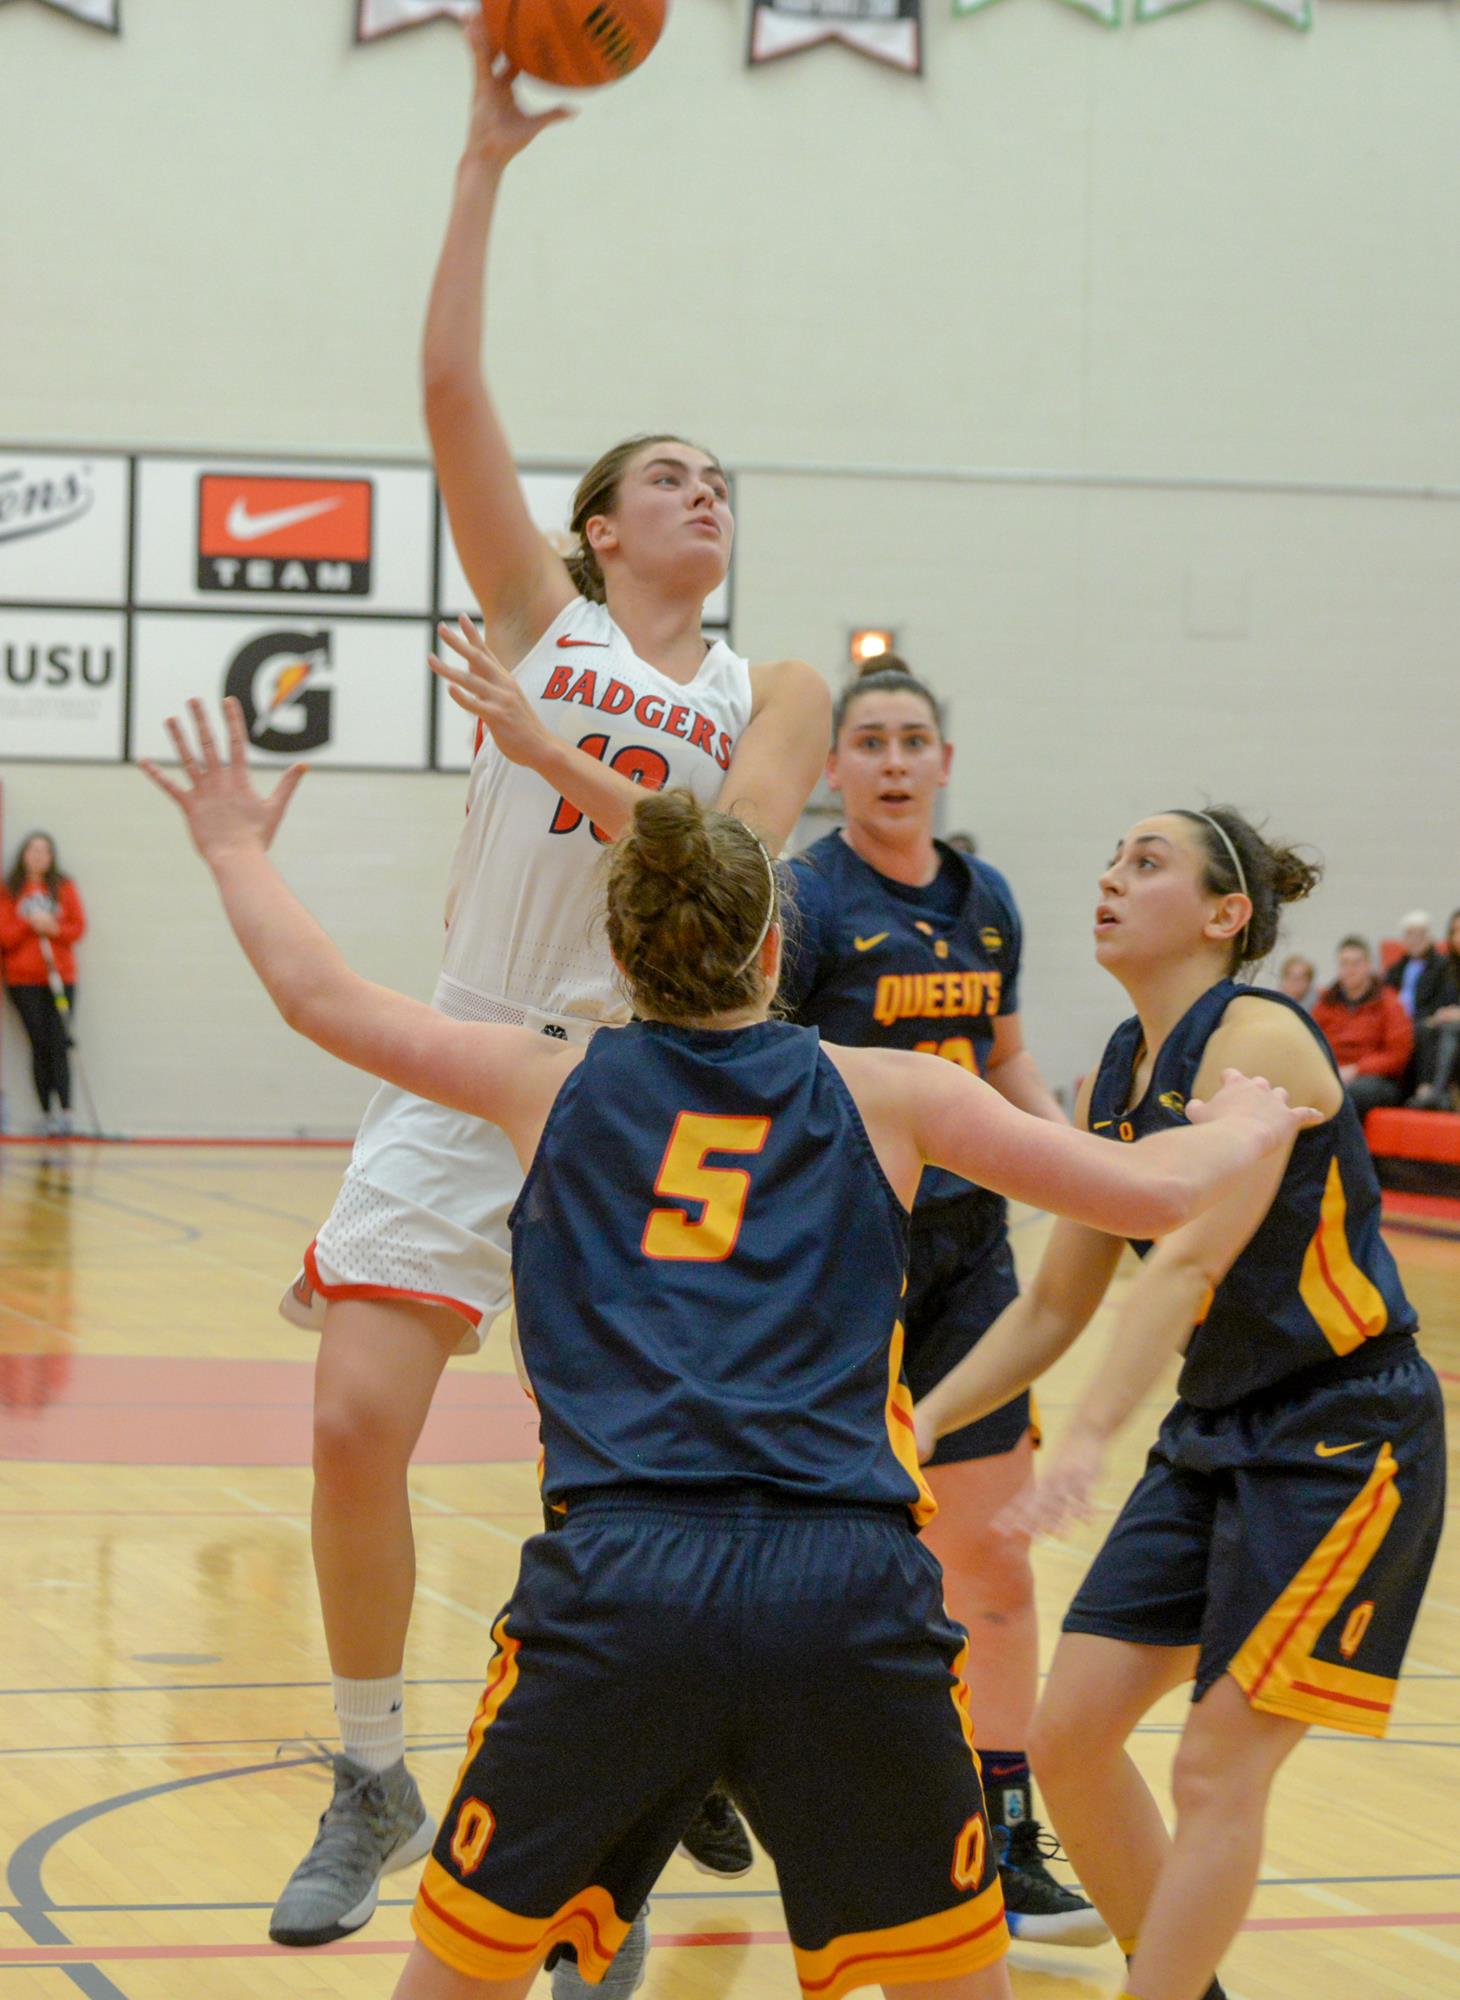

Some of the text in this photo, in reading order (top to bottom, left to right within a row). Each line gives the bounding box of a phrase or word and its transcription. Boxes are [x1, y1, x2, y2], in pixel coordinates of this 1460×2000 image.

[212, 557, 353, 590] TEAM
[5, 643, 114, 688] USU
[223, 629, 333, 753] G
[541, 665, 733, 772] BADGERS
[640, 1109, 772, 1262] 5
[450, 1795, 497, 1877] Q
[951, 1810, 987, 1892] Q
